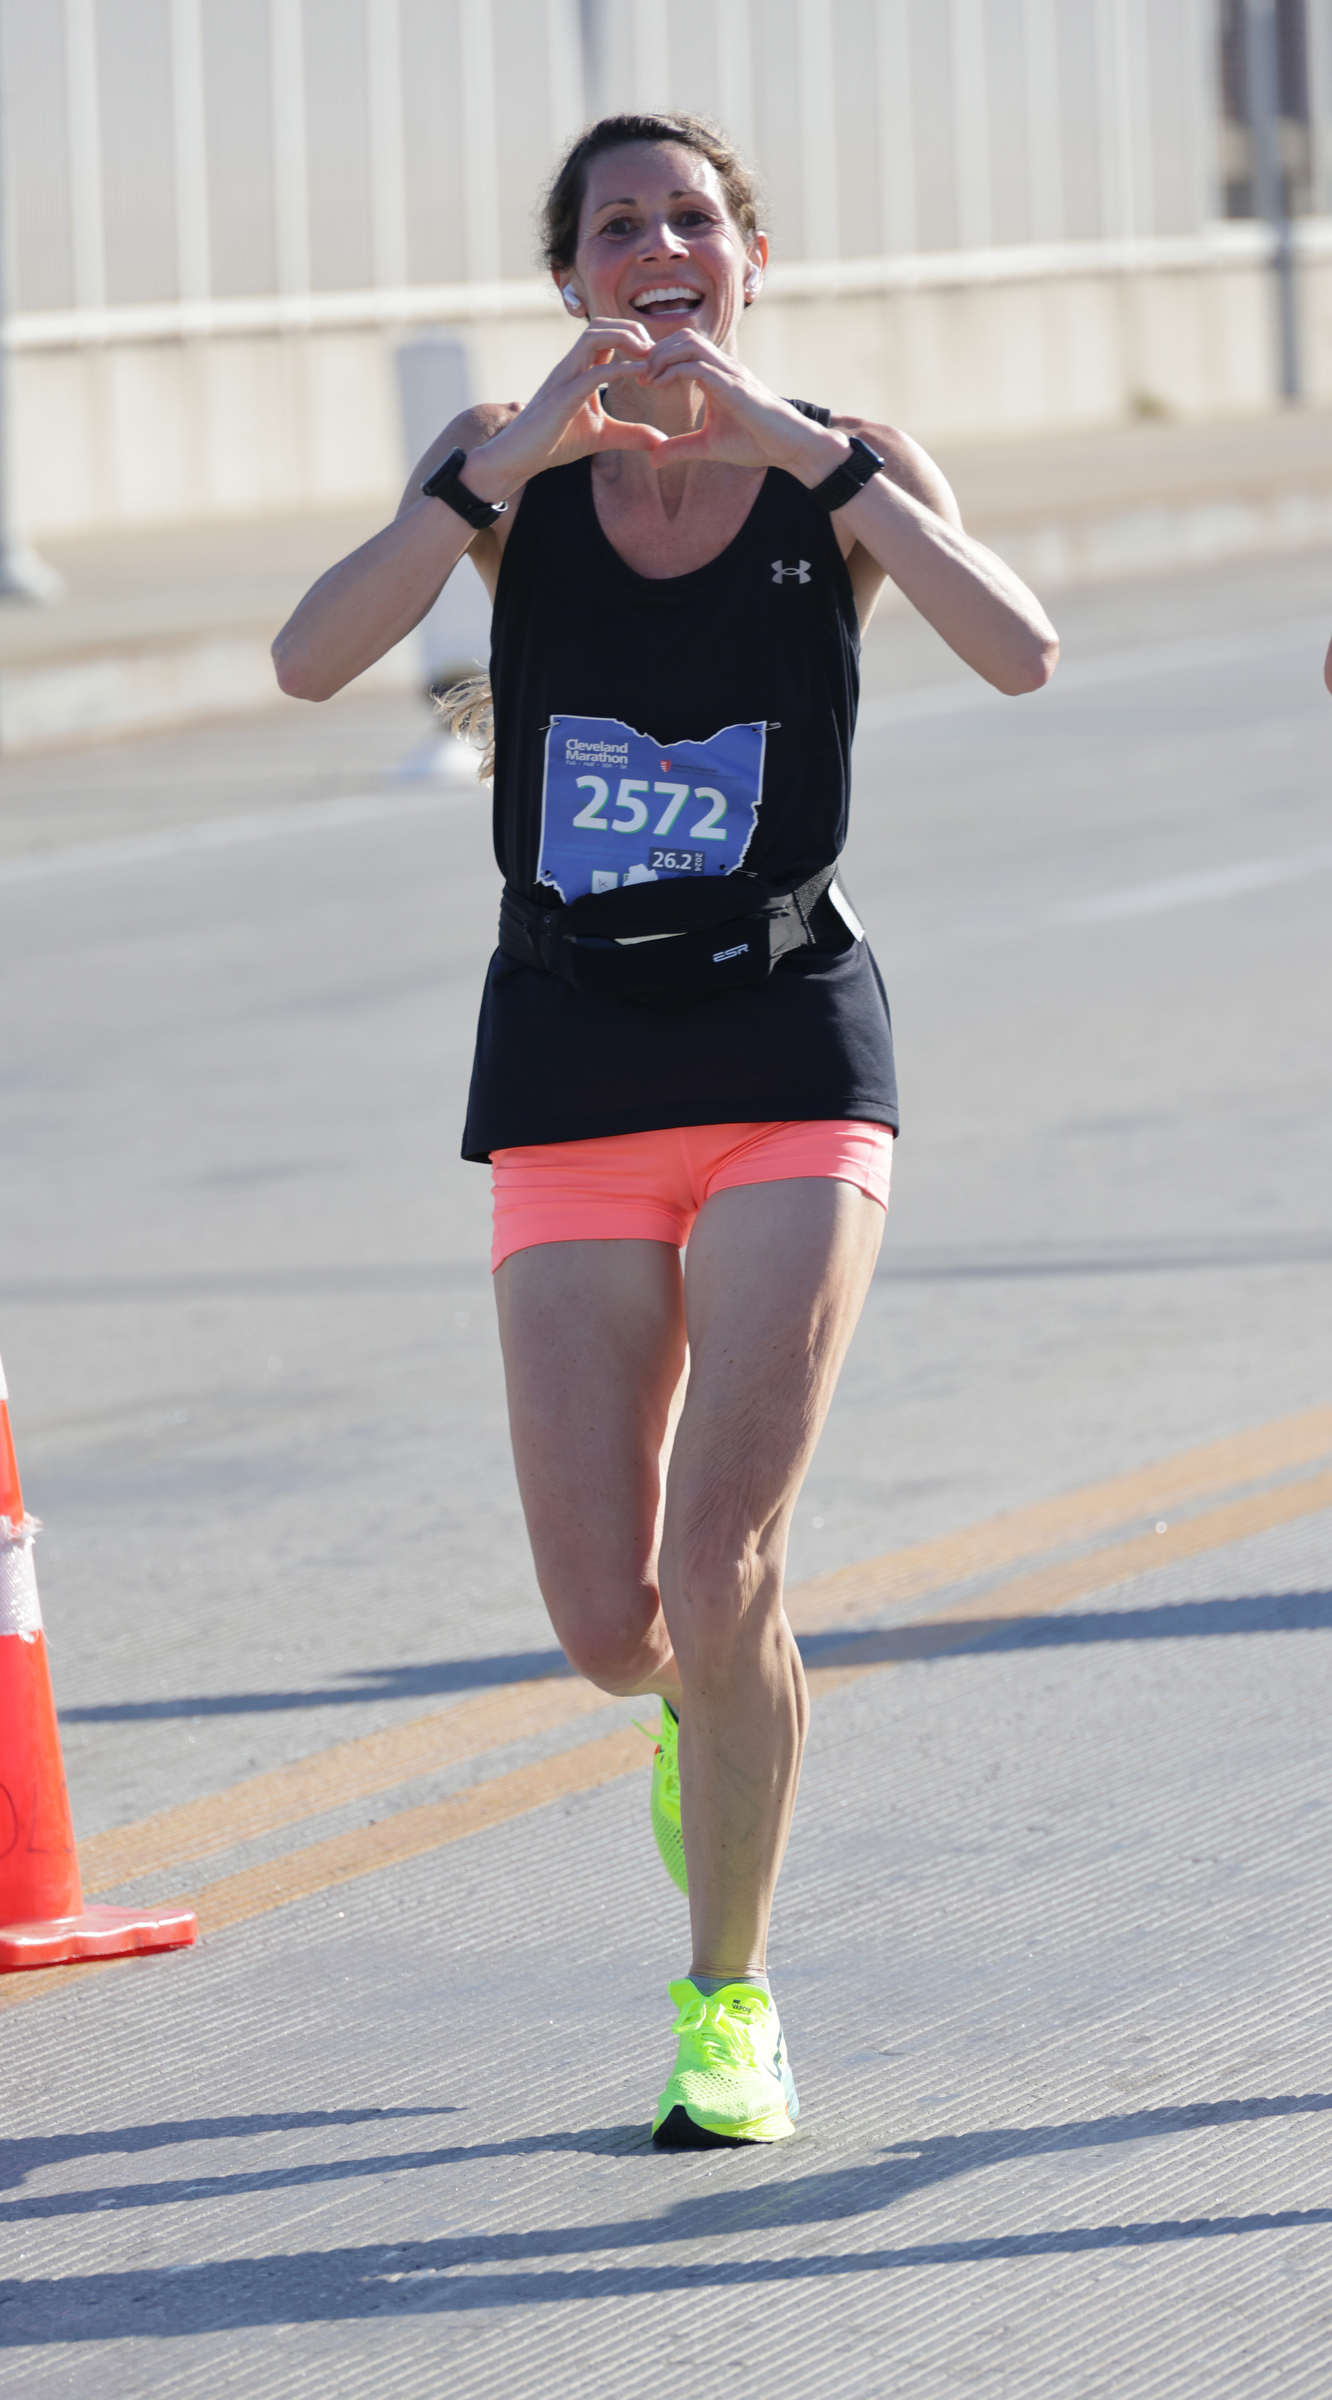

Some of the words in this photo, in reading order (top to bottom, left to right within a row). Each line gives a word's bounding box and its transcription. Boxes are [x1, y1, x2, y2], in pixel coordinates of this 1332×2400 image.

[565, 739, 628, 753] Cleveland
[565, 750, 628, 764] Marathon
[572, 775, 727, 841] 2572
[652, 851, 692, 870] 26.2
[694, 852, 703, 872] 2024
[712, 943, 749, 962] ESR
